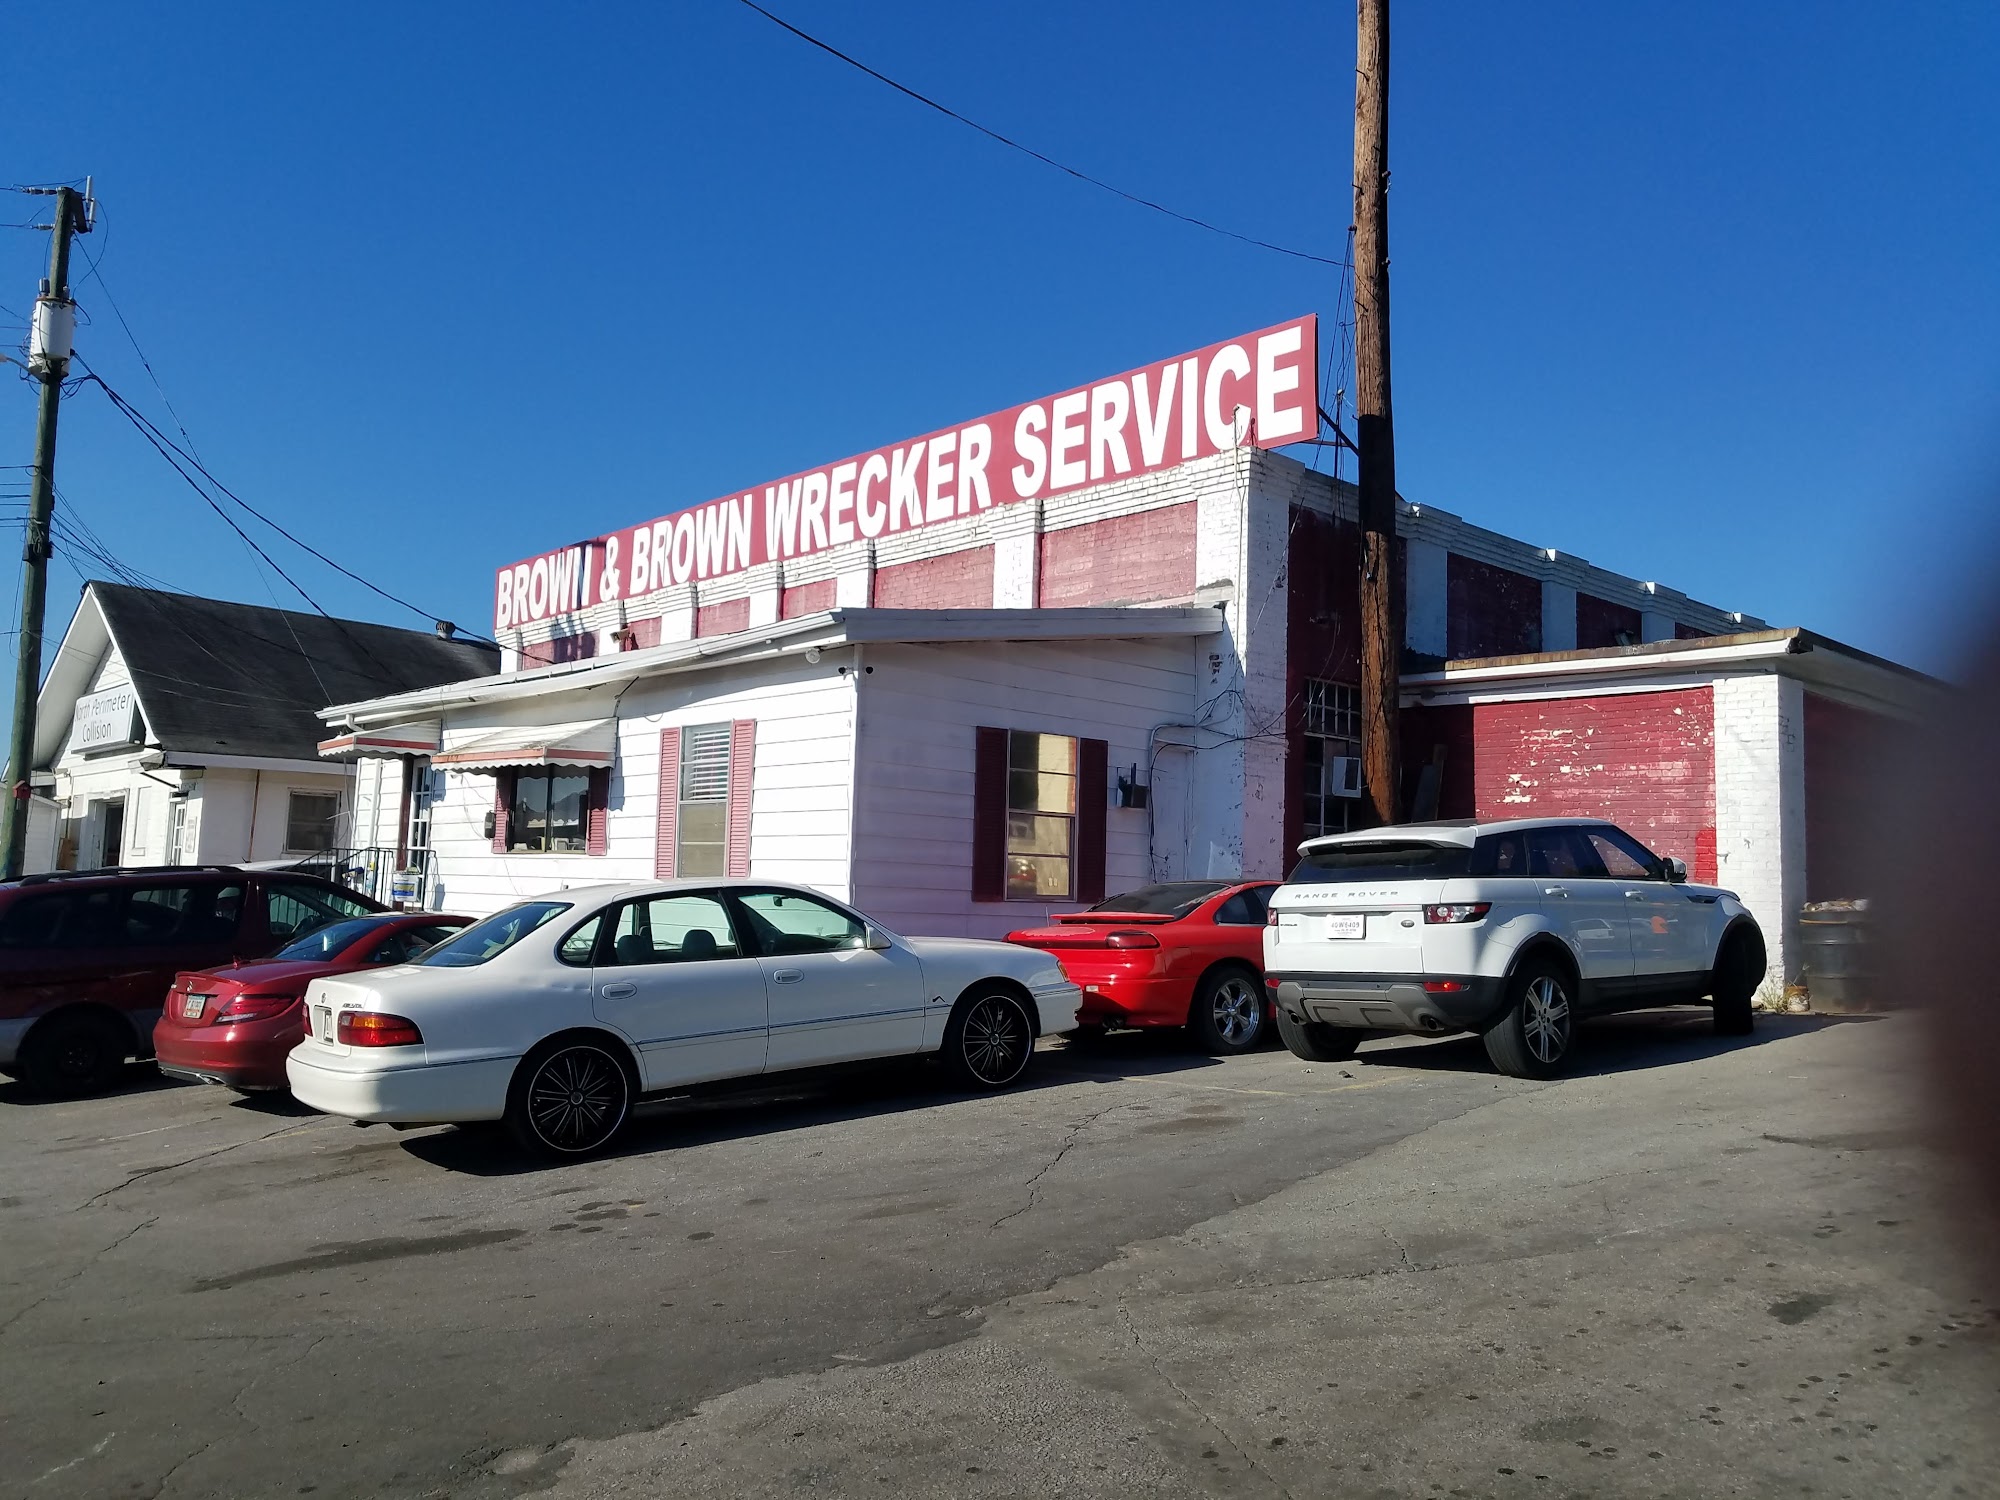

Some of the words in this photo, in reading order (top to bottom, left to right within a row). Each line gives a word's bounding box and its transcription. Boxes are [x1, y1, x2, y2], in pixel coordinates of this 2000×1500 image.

[497, 543, 594, 629] BROWN
[599, 536, 620, 602] &
[629, 494, 753, 596] BROWN
[765, 424, 992, 561] WRECKER
[1012, 326, 1303, 497] SERVICE
[91, 693, 131, 717] Perimeter
[82, 719, 112, 742] Collision
[1294, 892, 1338, 900] RANGE
